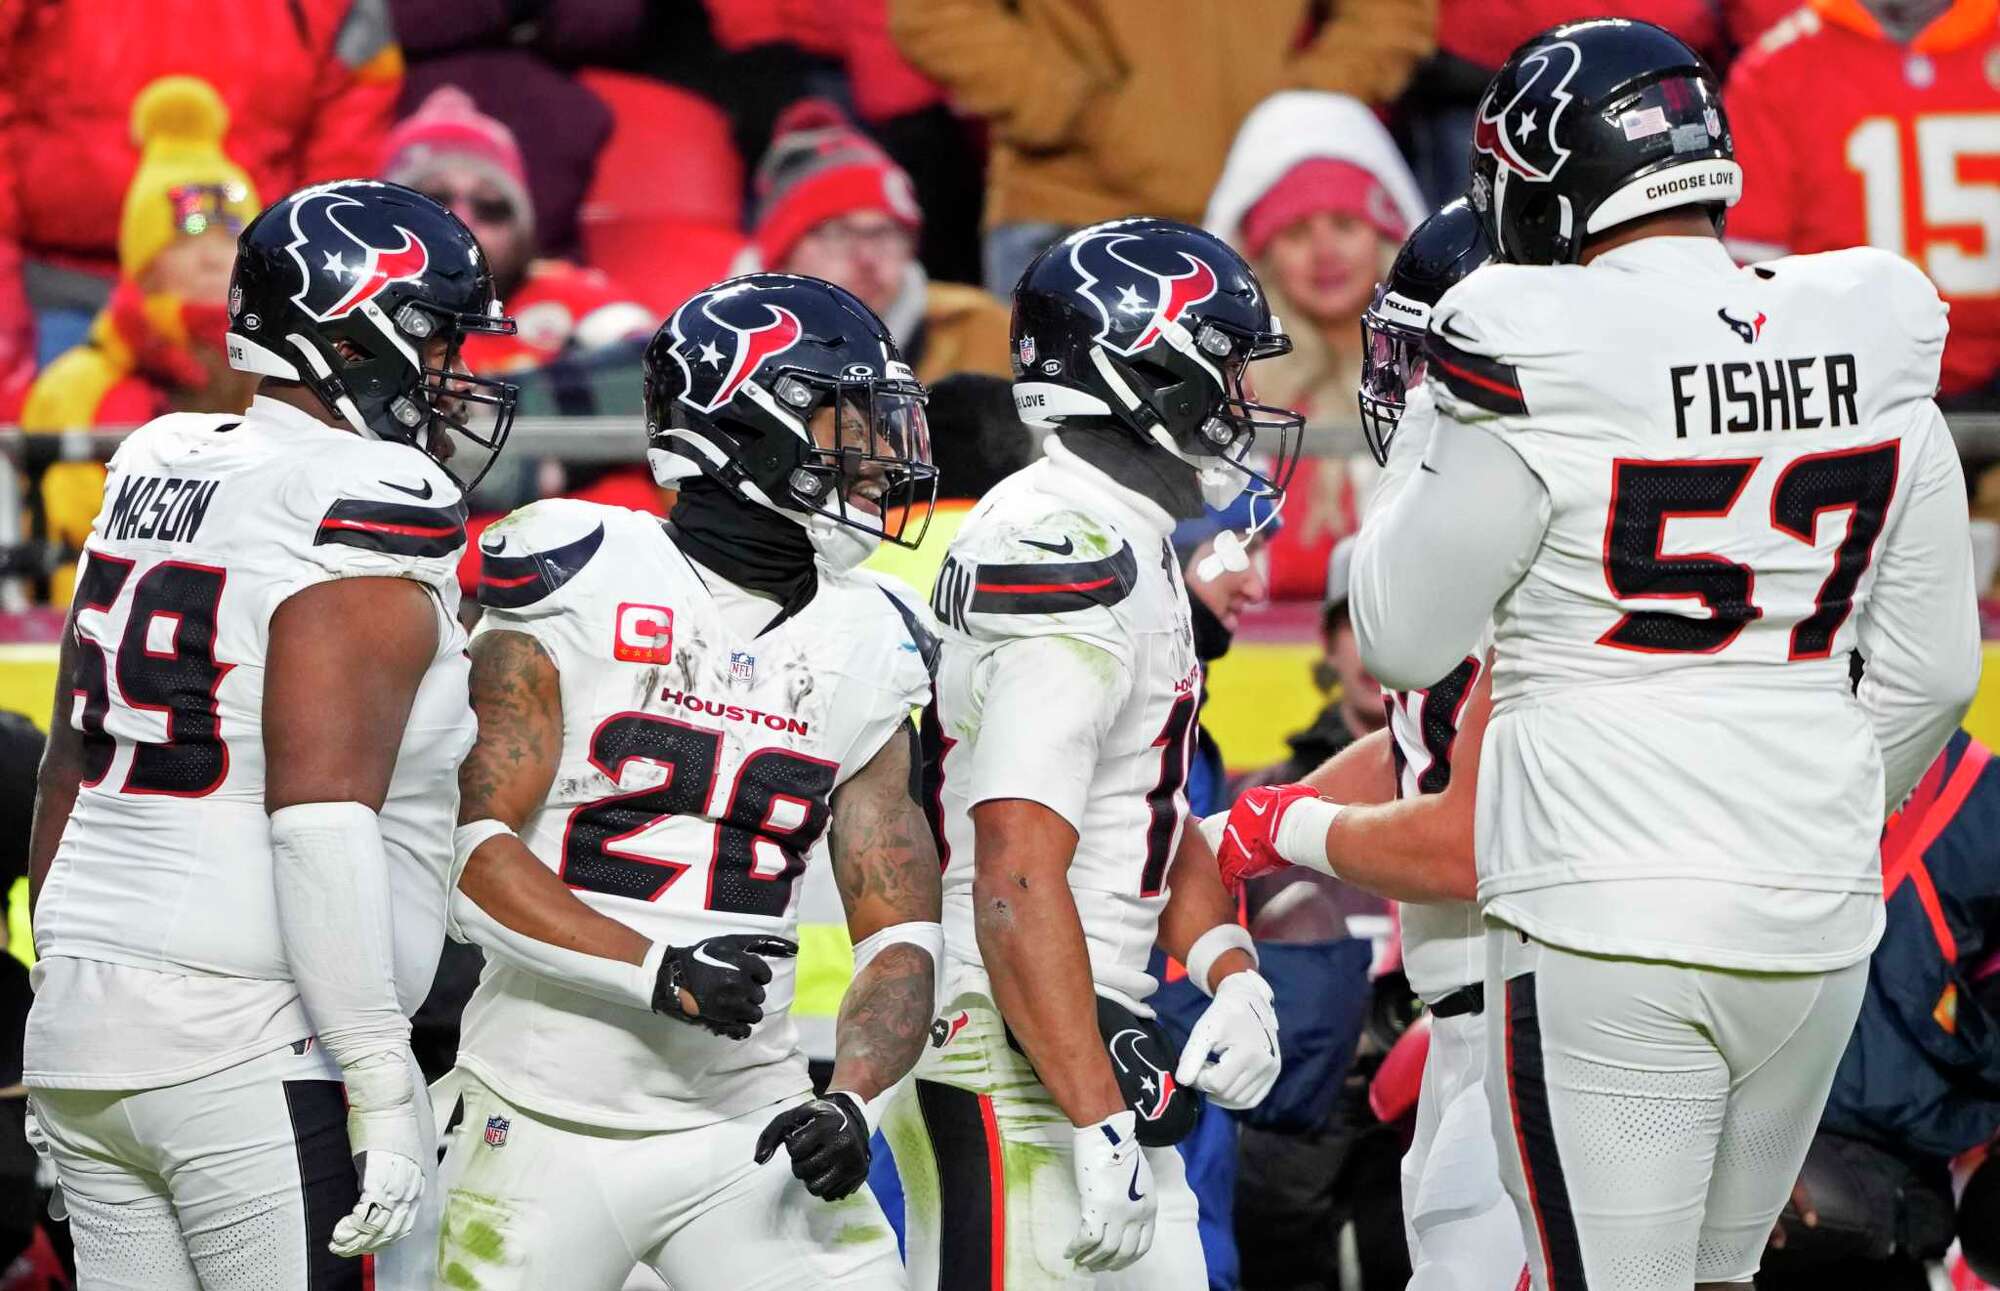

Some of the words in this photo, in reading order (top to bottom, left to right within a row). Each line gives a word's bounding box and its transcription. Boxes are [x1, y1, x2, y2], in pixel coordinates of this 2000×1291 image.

[1645, 174, 1707, 200] CHOOSE
[1709, 172, 1734, 186] LOVE
[1845, 113, 2000, 296] 15
[1385, 298, 1422, 317] TEXANS
[1021, 393, 1046, 409] LOVE
[1670, 353, 1860, 439] FISHER
[103, 474, 220, 544] MASON
[1594, 437, 1902, 662] 57
[620, 605, 672, 649] C
[928, 549, 973, 637] ON
[660, 687, 809, 737] HOUSTON
[558, 710, 841, 918] 28
